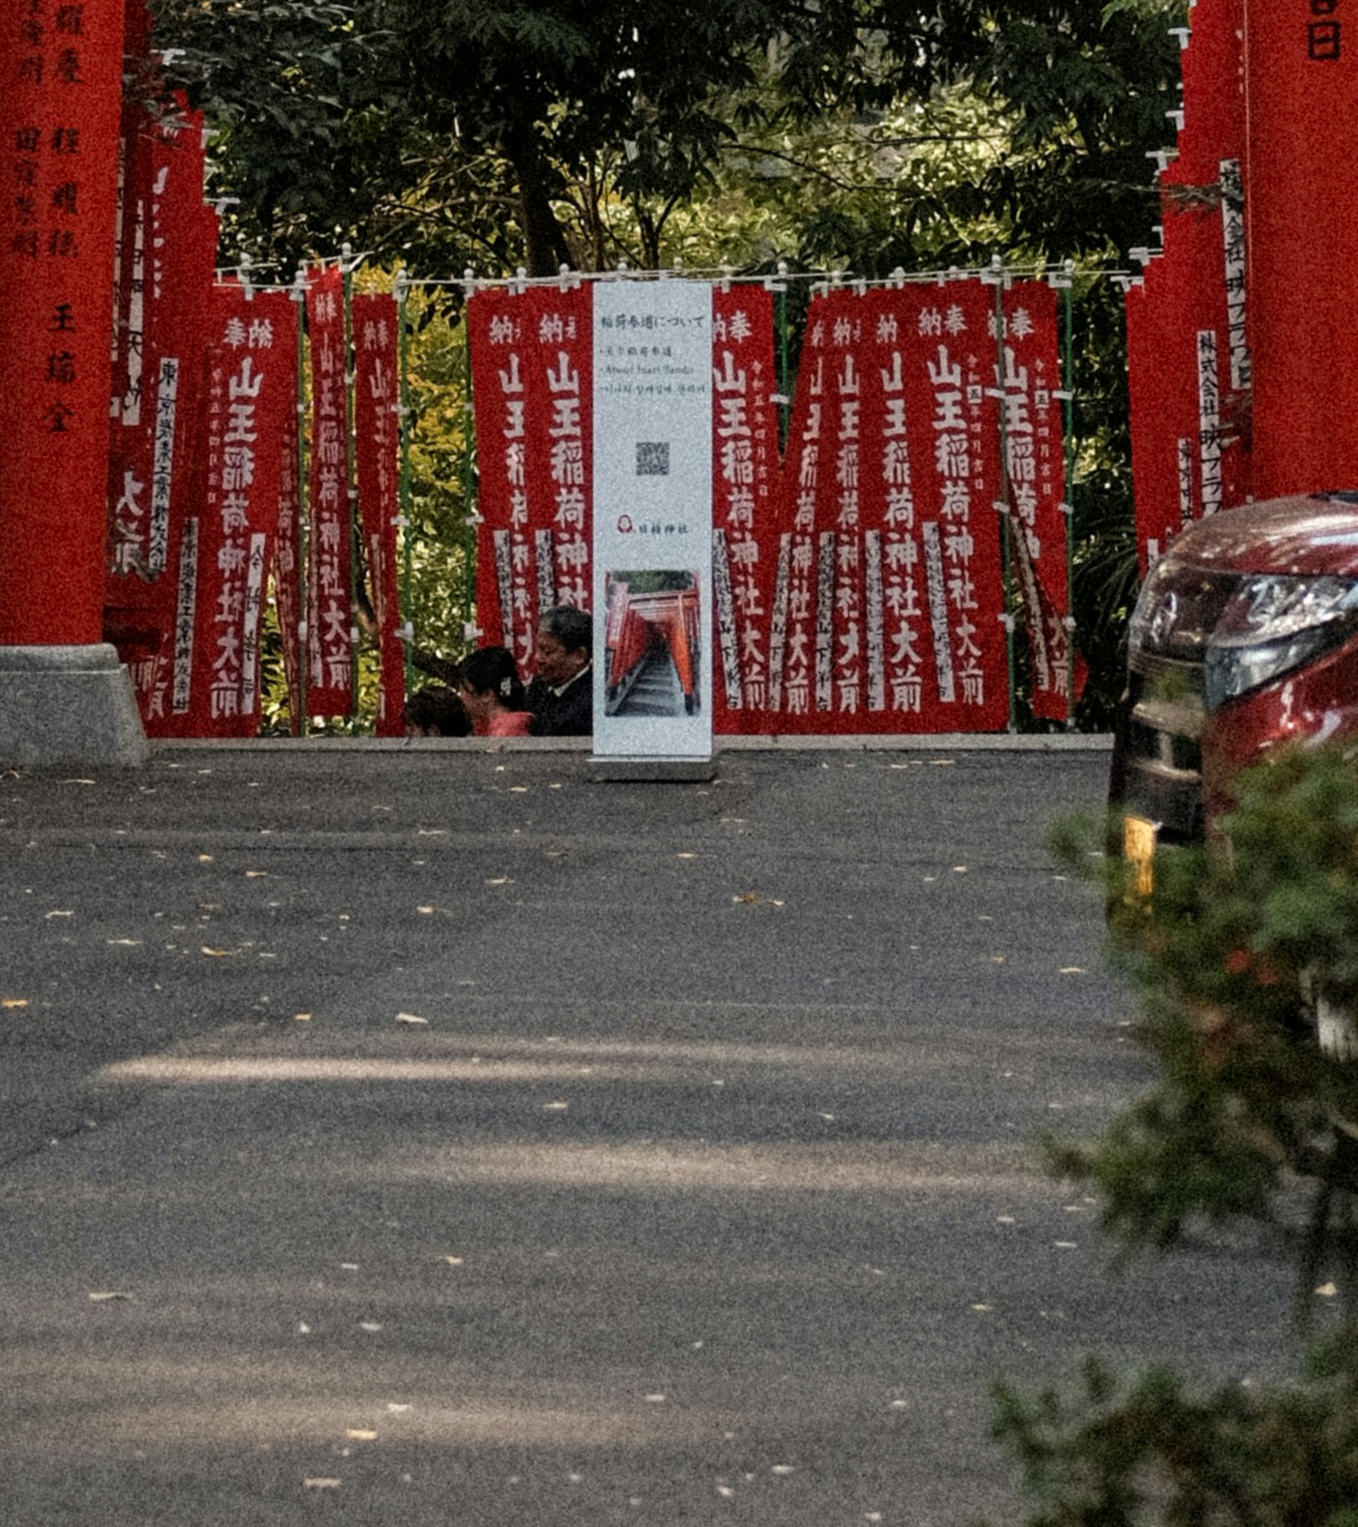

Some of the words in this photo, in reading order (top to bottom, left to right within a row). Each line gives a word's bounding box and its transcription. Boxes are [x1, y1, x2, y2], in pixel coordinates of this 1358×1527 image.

[918, 304, 968, 337] 奉納
[712, 350, 766, 712] 山王稲荷神社大前
[926, 344, 985, 706] 山王稲荷神社大前
